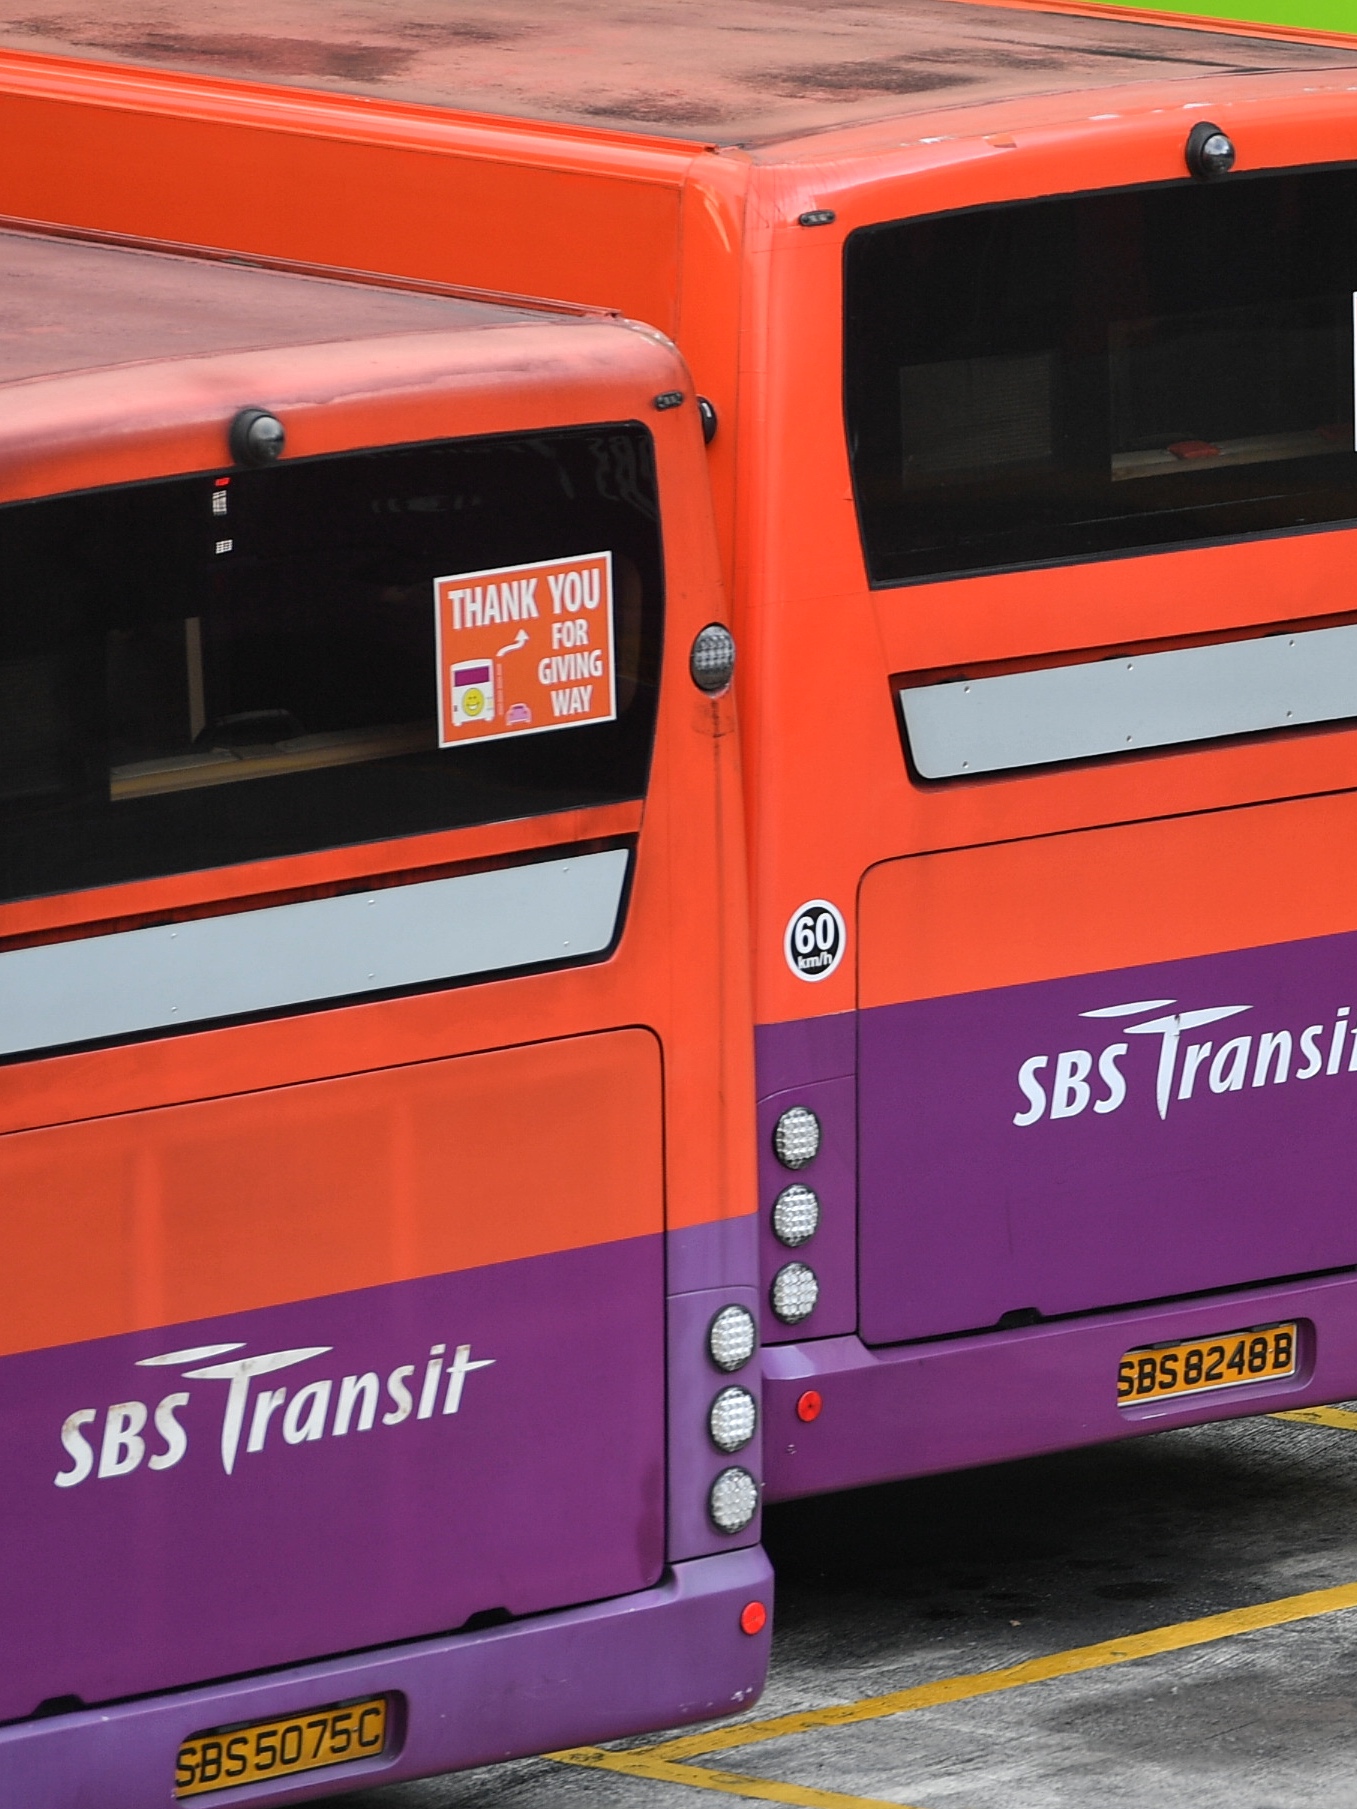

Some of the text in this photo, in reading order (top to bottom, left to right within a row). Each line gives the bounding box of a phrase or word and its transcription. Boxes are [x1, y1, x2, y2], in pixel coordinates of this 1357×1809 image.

[448, 568, 600, 630] THANK YOU
[552, 619, 589, 650] FOR
[538, 649, 603, 685] GIVING
[551, 685, 593, 717] WAY
[795, 912, 835, 954] 60
[797, 951, 833, 969] km/h
[1013, 1043, 1128, 1126] SBS
[1117, 1332, 1292, 1397] SBS8248B
[54, 1344, 496, 1487] SBS Transit
[175, 1707, 381, 1788] SBS5075C
